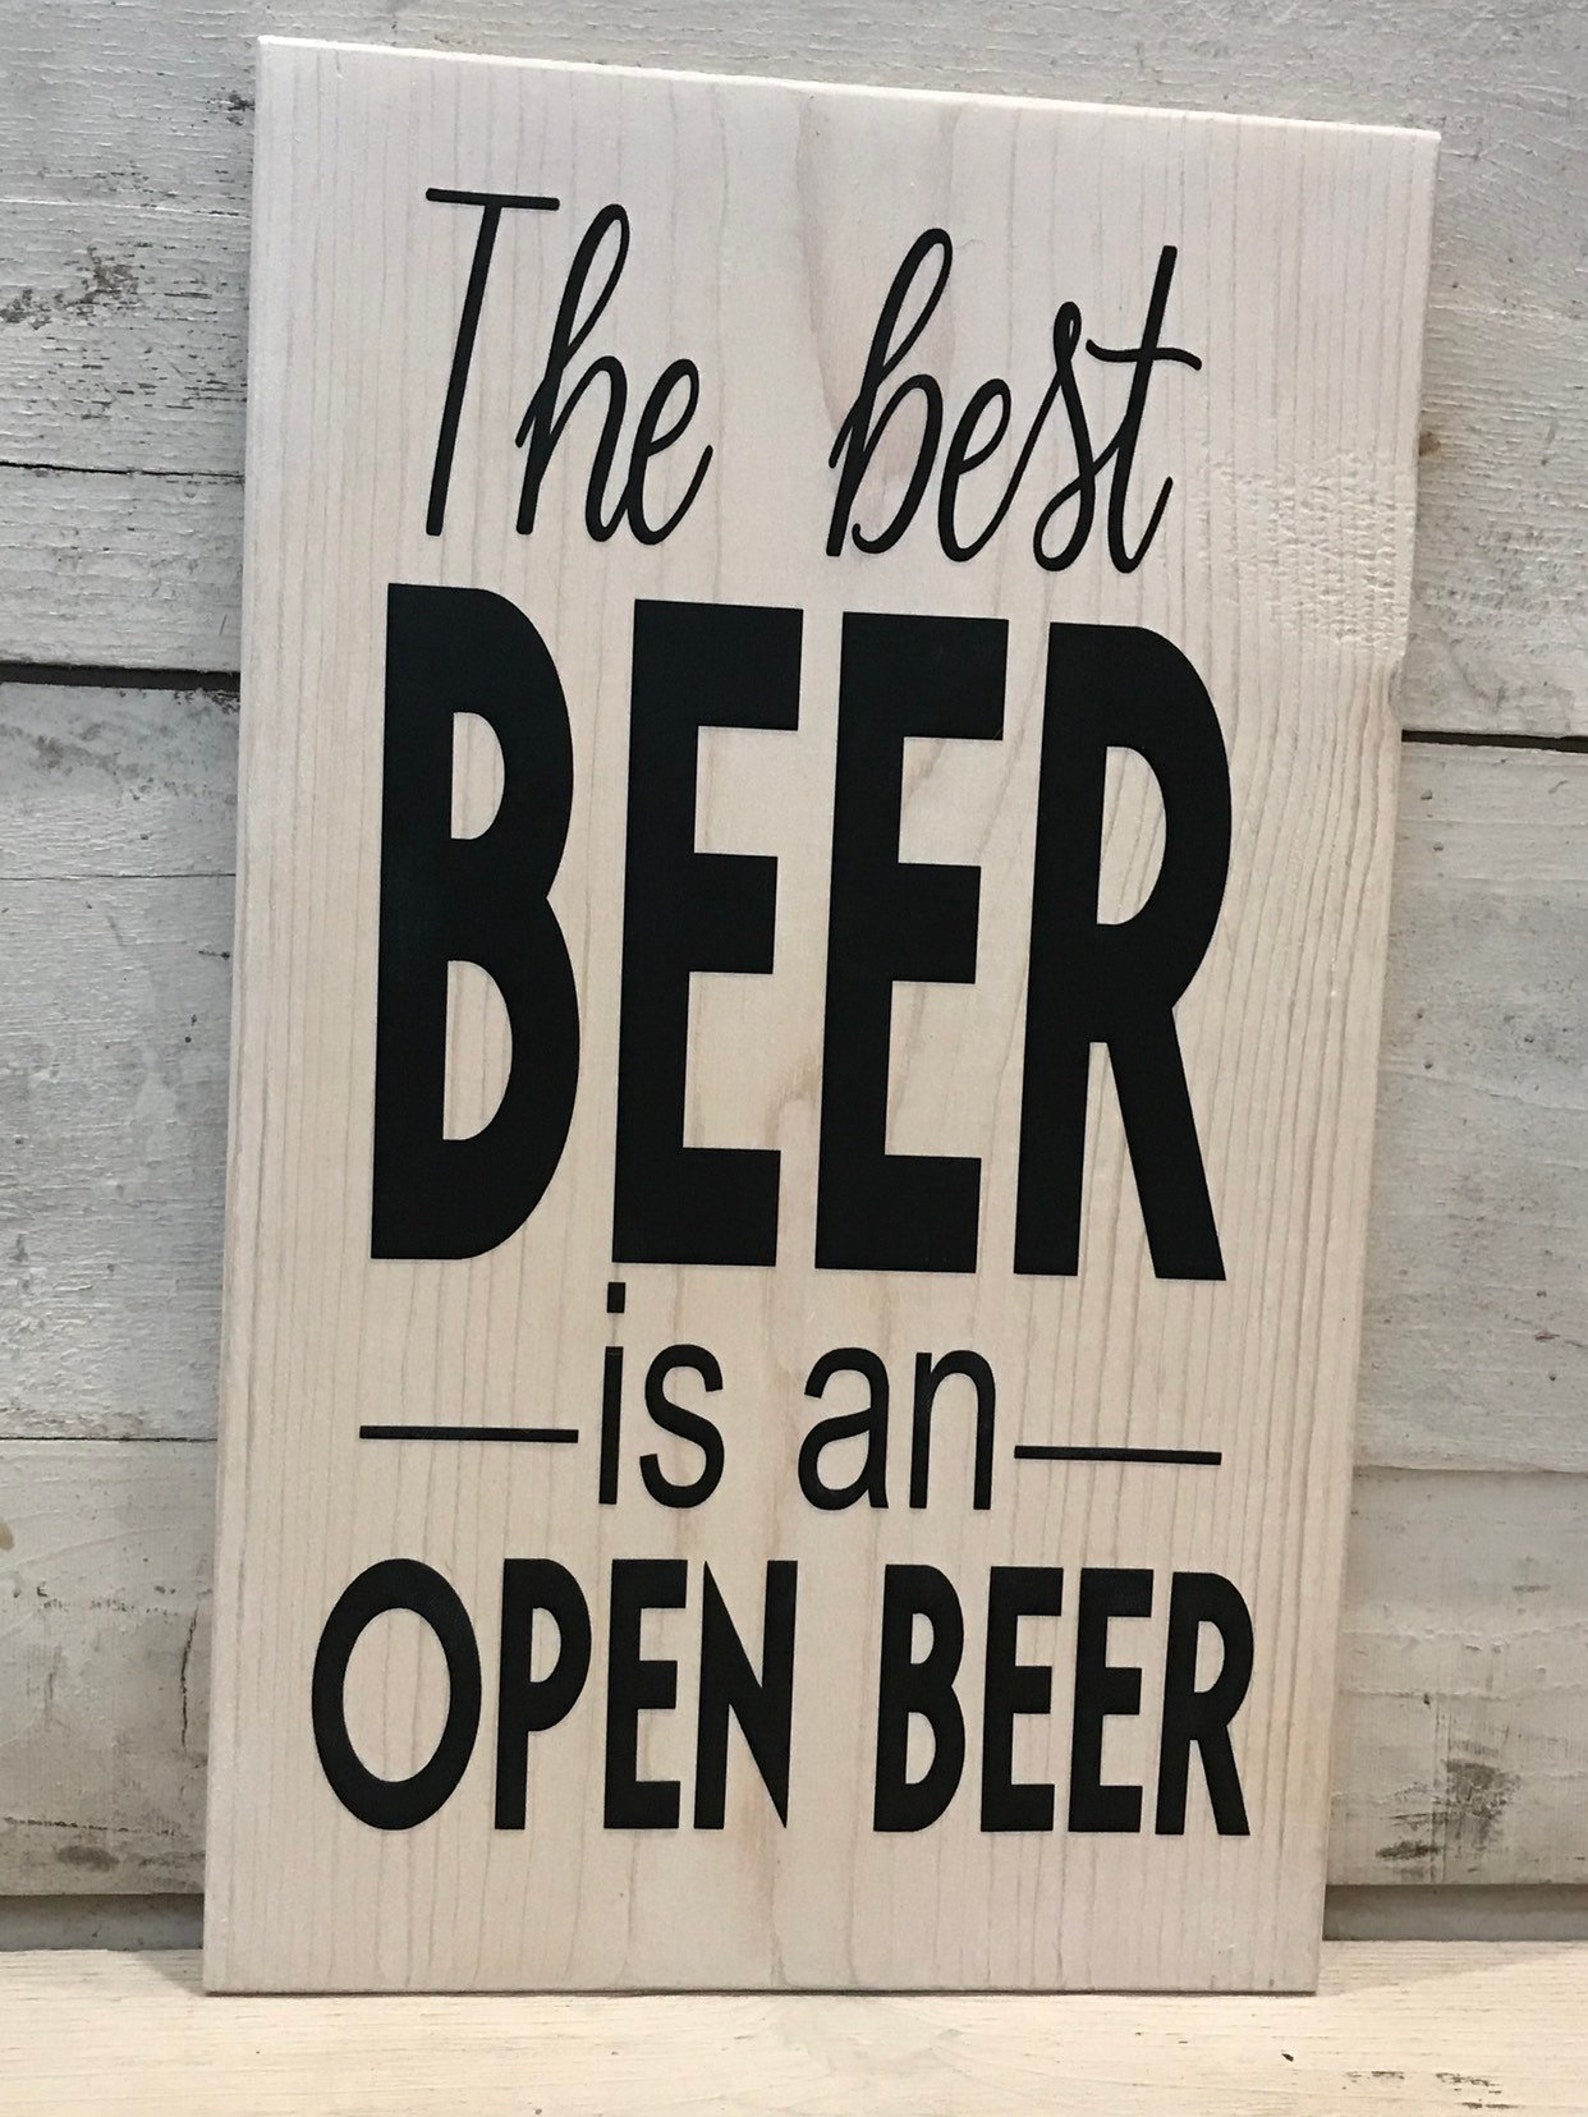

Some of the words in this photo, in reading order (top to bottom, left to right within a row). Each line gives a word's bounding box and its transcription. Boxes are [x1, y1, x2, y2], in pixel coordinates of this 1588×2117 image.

[425, 186, 714, 546] The
[825, 227, 1203, 574] best
[370, 582, 1233, 1282] BEER
[598, 1280, 726, 1509] is
[797, 1346, 997, 1512] an
[311, 1557, 799, 1832] OPEN
[872, 1563, 1256, 1838] BEER
